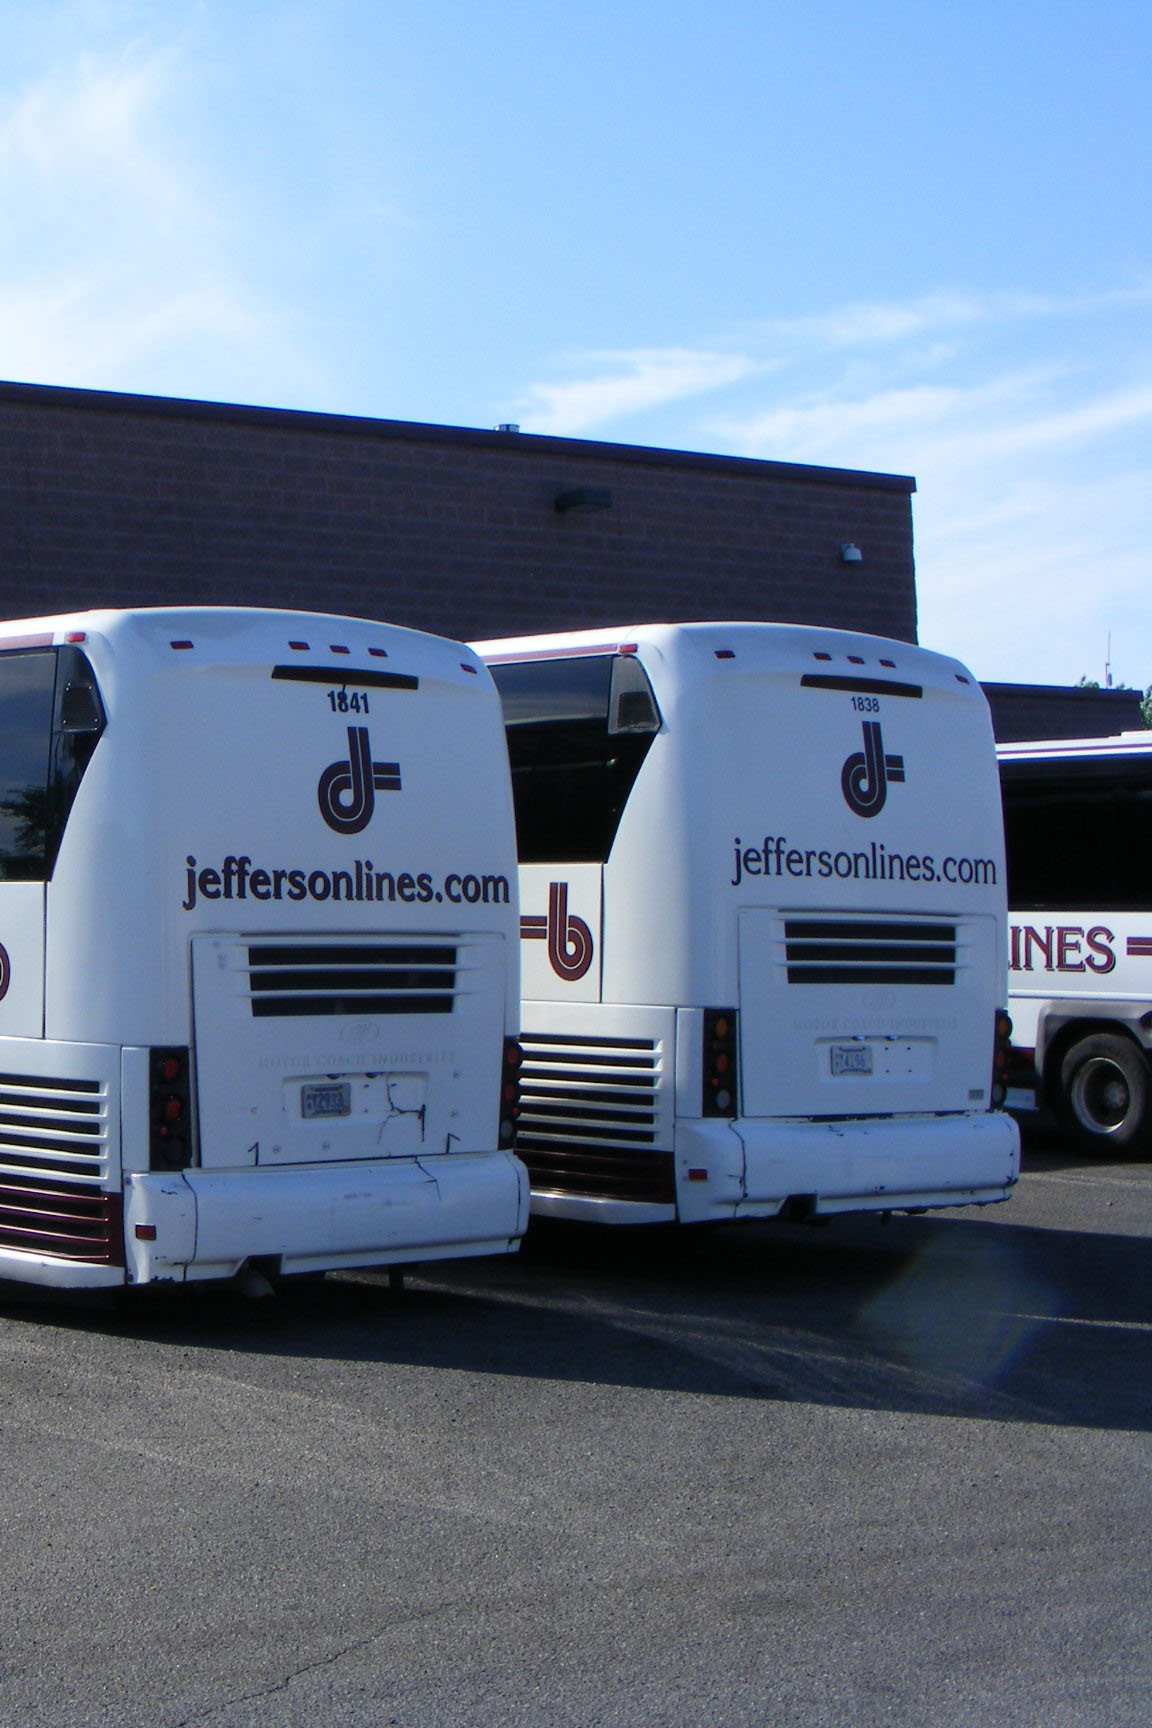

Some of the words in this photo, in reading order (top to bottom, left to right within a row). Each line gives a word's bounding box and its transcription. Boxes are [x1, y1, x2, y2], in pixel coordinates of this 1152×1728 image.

[327, 690, 370, 714] 1841
[850, 696, 880, 712] 1838
[182, 855, 510, 911] jeffersonlines.com
[731, 836, 998, 886] jeffersonlines.com
[1008, 925, 1117, 975] INES
